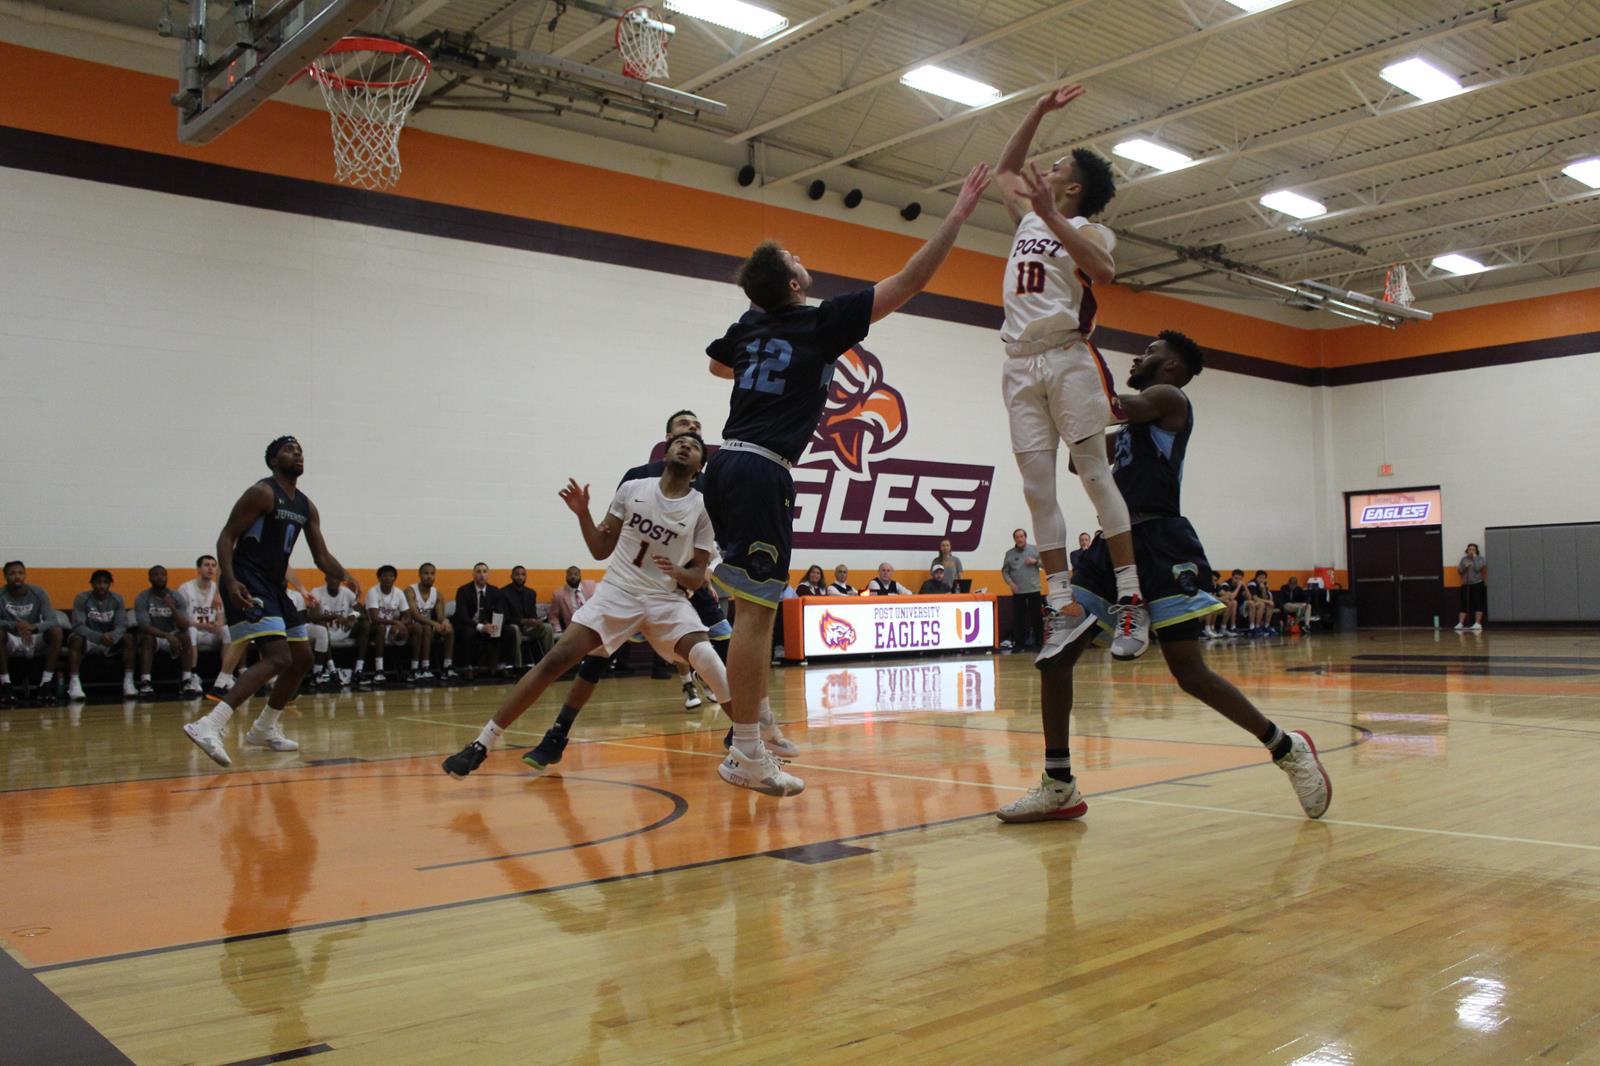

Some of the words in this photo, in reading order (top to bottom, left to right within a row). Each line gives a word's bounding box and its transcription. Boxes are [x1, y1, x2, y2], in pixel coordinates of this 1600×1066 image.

[1013, 238, 1064, 258] POST
[1016, 261, 1046, 295] 10
[739, 337, 793, 395] 12
[792, 467, 981, 537] GLES
[1365, 505, 1426, 520] EAGLES
[629, 512, 679, 547] POST
[632, 540, 650, 568] 1
[874, 607, 894, 620] POST
[895, 606, 940, 619] UNIVERSITY
[874, 620, 941, 649] EAGLES
